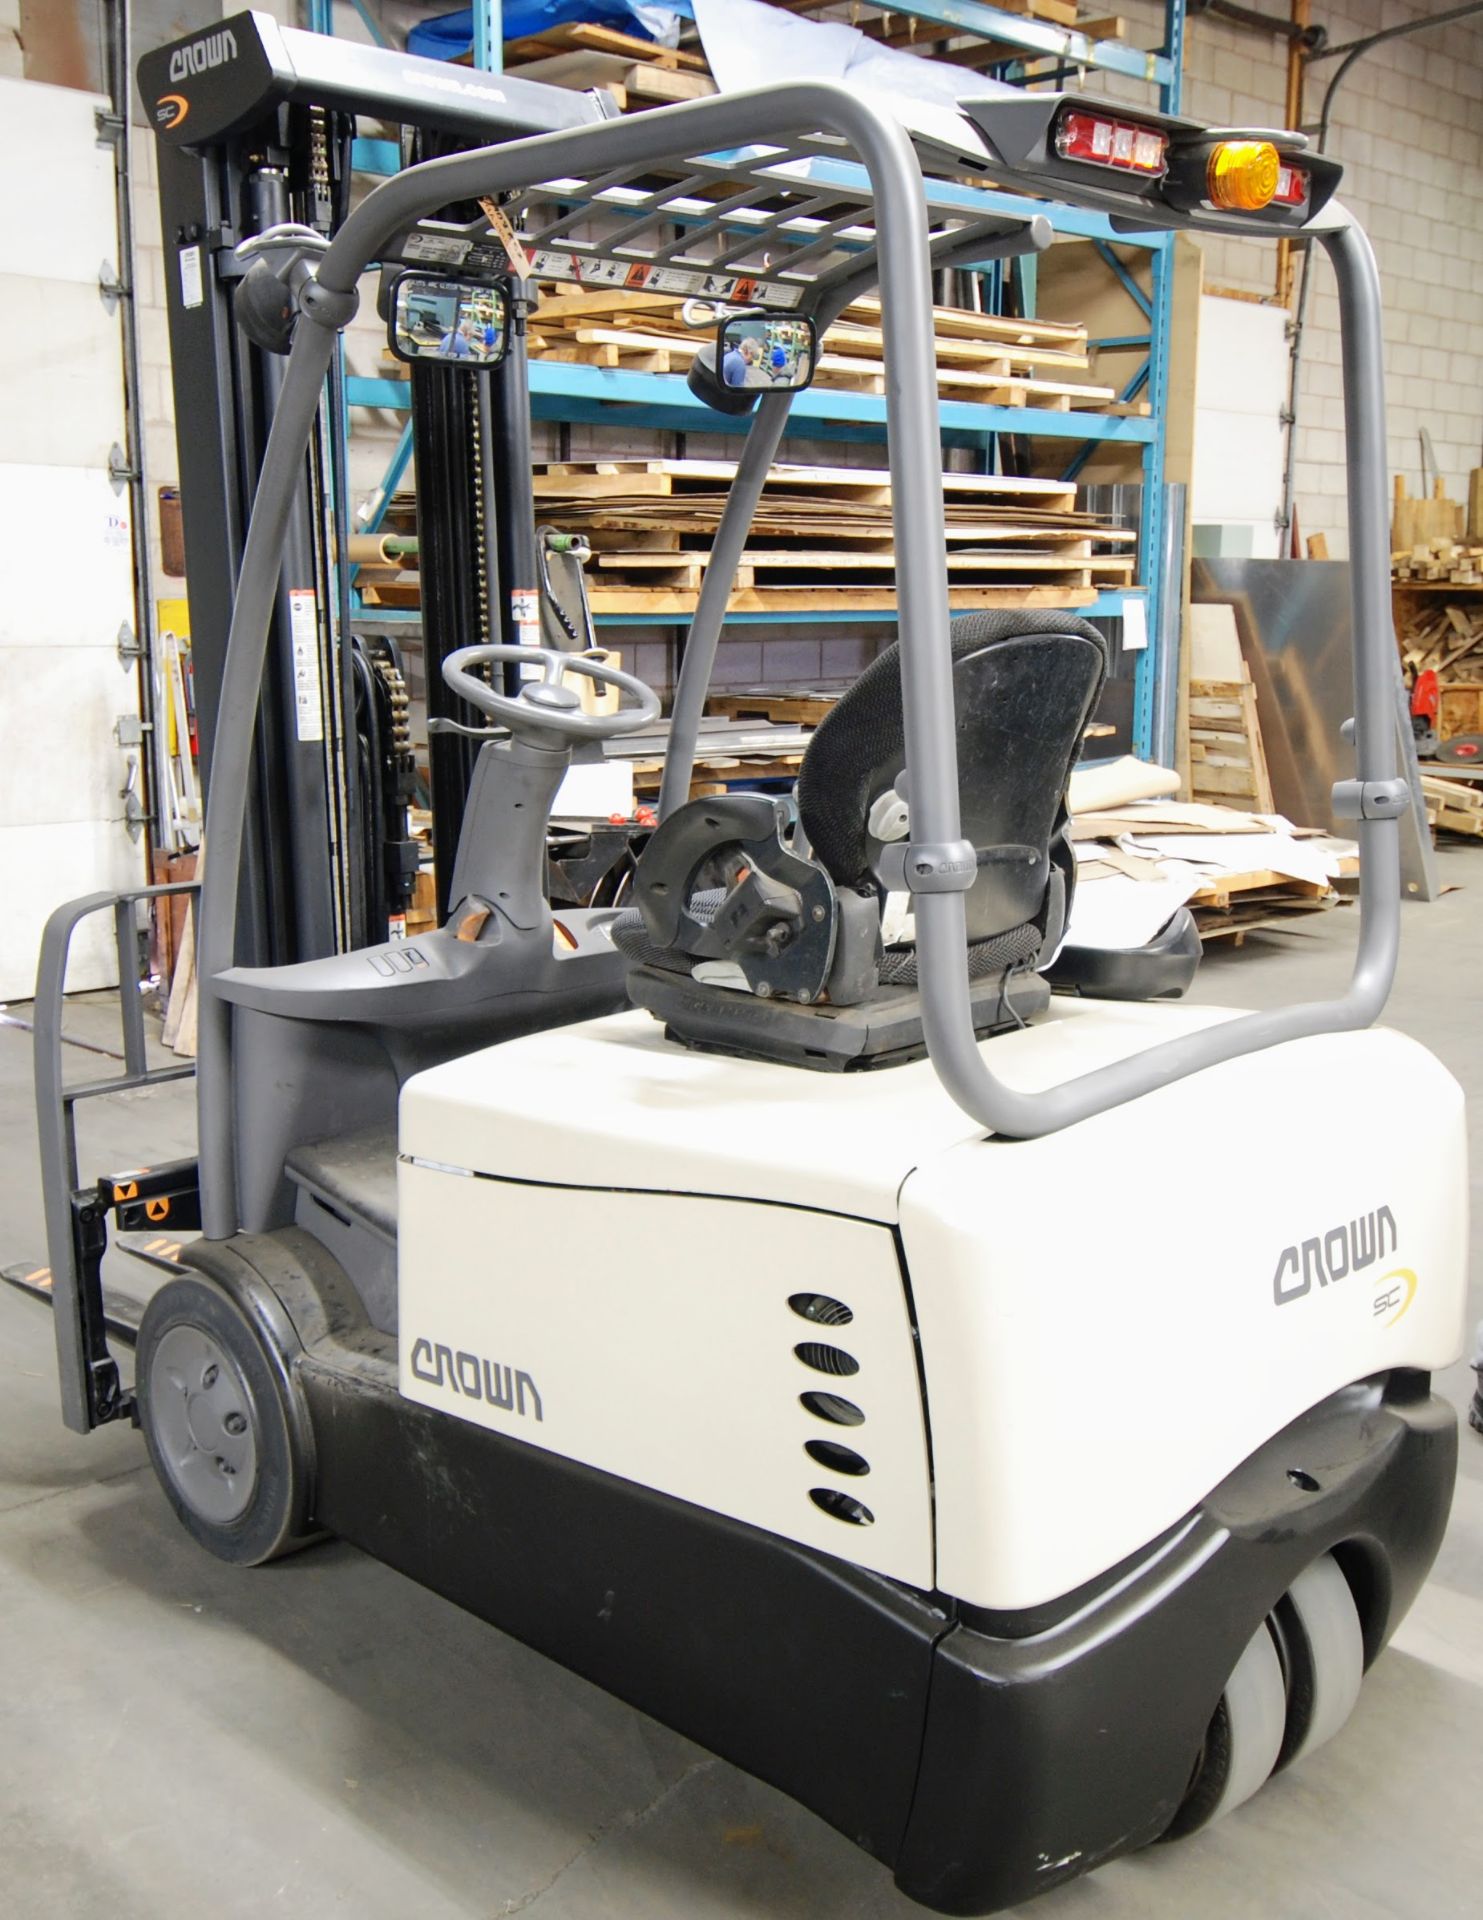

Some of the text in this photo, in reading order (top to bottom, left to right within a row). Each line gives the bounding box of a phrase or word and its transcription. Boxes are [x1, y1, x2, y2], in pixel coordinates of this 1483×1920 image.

[169, 29, 238, 82] CROWN
[156, 105, 177, 122] SC
[1273, 1204, 1397, 1306] CROWN
[1373, 1285, 1401, 1317] SC
[410, 1337, 543, 1422] CROWN
